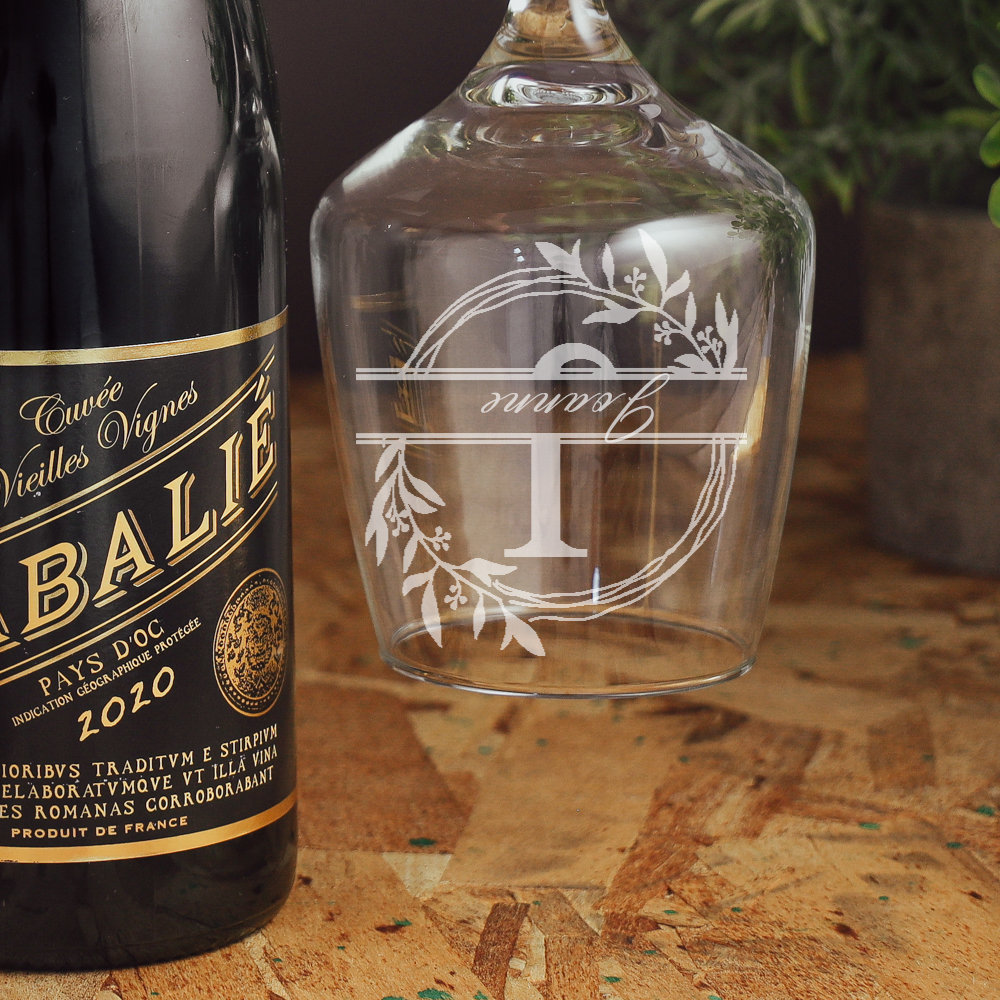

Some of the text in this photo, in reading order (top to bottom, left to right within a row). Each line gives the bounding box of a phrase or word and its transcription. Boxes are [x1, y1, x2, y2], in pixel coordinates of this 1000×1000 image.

[19, 376, 123, 436] Cuvée
[97, 382, 199, 454] Vignes
[480, 373, 670, 442] Joanne
[11, 617, 202, 727] INDICATION GÉOGRAPHIQUE PROTÉGÉE
[38, 618, 165, 697] PAYS D'OC
[77, 666, 175, 742] 2020
[2, 774, 173, 799] ELABORATVMQVE
[182, 768, 205, 786] VT
[252, 744, 278, 767] VINA
[92, 750, 194, 777] TRADITVM
[203, 747, 212, 763] E
[220, 723, 278, 758] STIRPIVM
[34, 800, 135, 820] ROMANAS
[145, 765, 274, 812] CORROBORABANT
[11, 816, 188, 839] PRODUIT DE FRANCE
